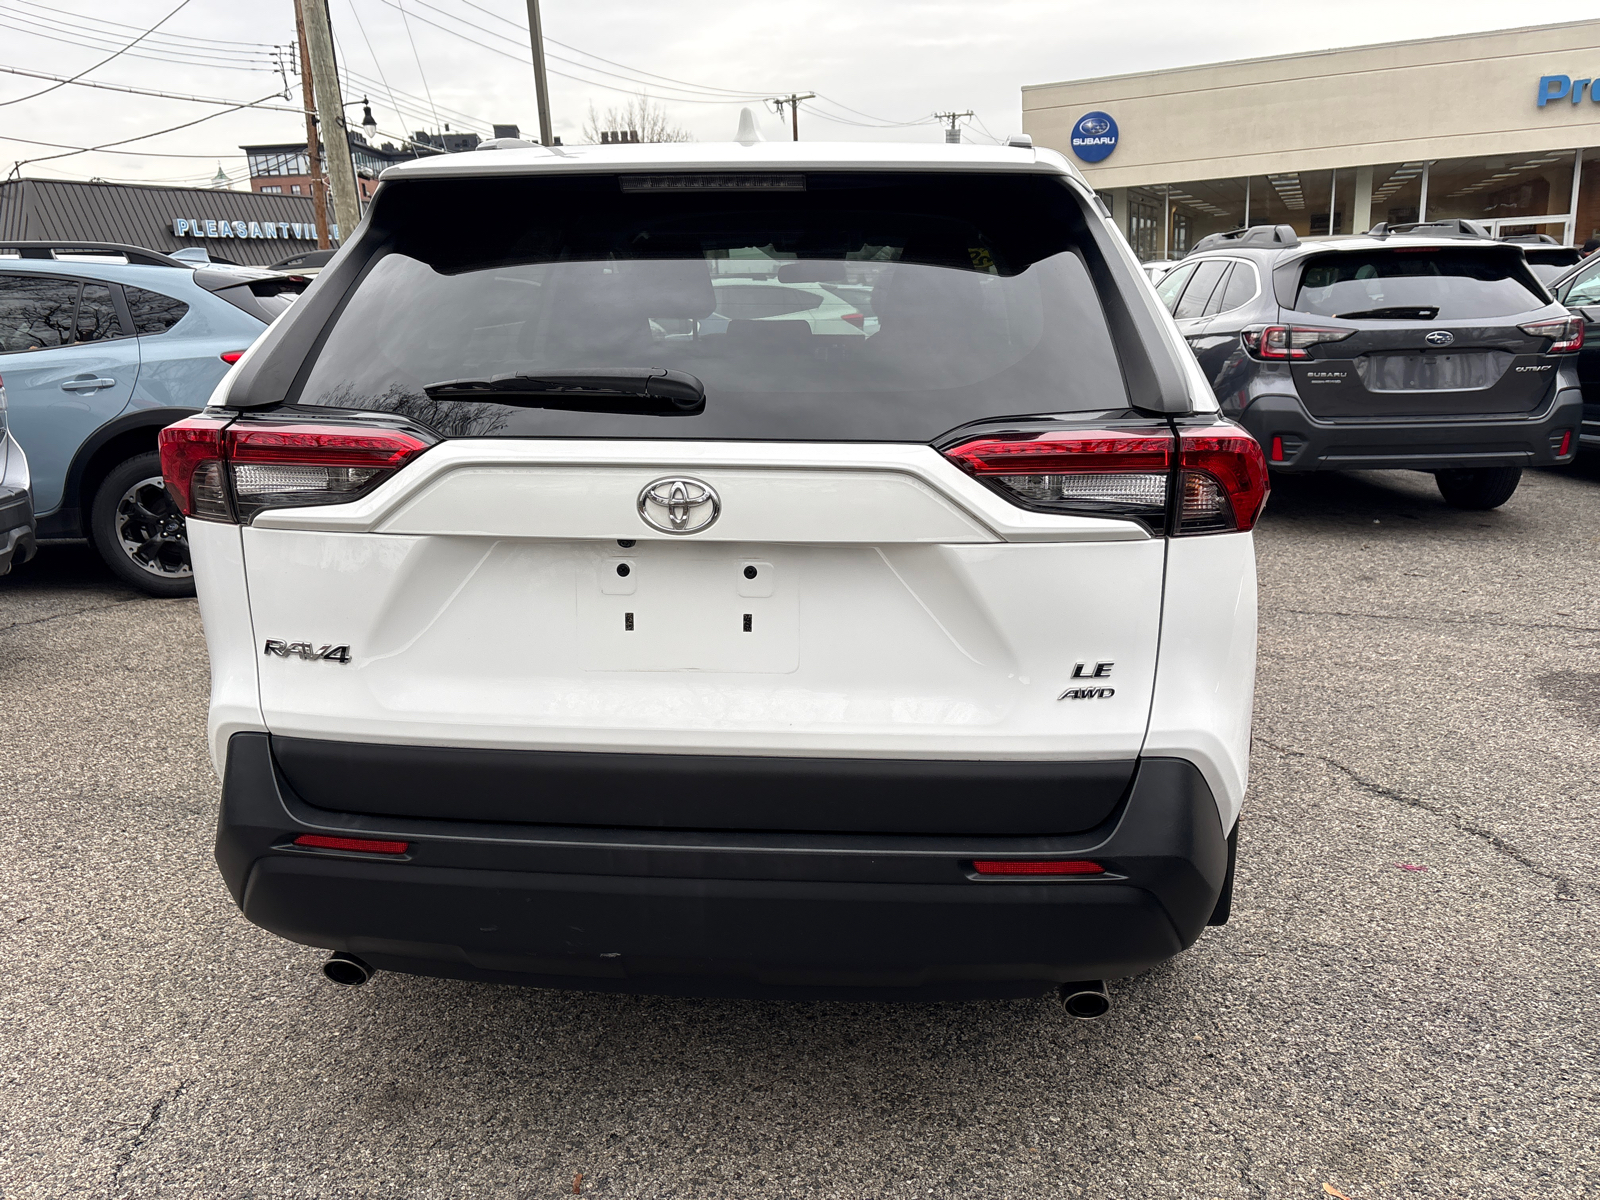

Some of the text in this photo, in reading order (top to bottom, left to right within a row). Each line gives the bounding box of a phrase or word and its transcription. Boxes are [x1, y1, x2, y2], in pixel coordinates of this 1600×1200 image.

[1072, 136, 1115, 146] SUBARU
[173, 218, 340, 240] PLEASANTVILE
[263, 637, 352, 664] RAV4
[1070, 660, 1115, 679] LE
[1057, 685, 1116, 701] AWD
